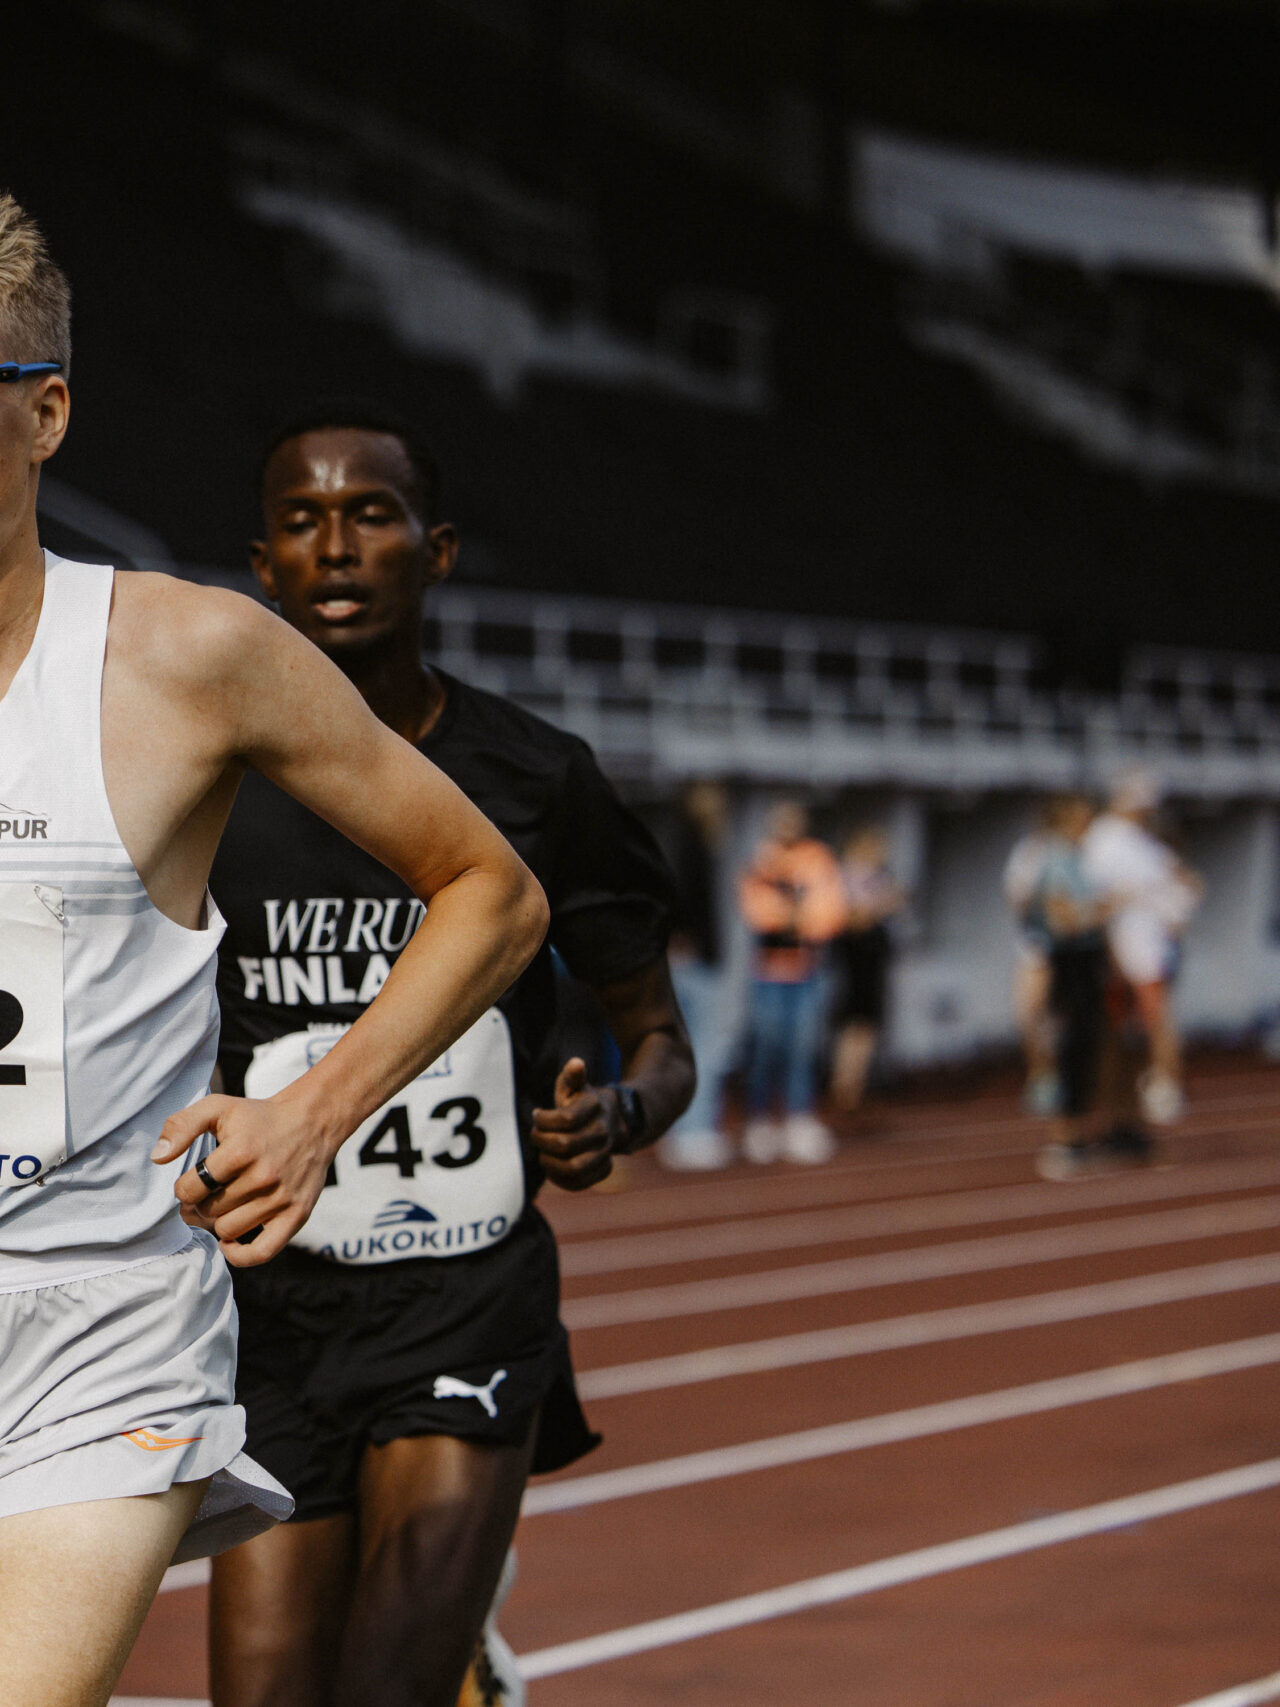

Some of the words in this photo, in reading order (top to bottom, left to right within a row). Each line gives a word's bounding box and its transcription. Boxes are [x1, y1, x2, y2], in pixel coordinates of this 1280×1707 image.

[263, 897, 344, 954] WE
[343, 897, 428, 953] RU
[238, 954, 392, 1006] FINLA
[320, 1216, 508, 1261] AUKOKIITO
